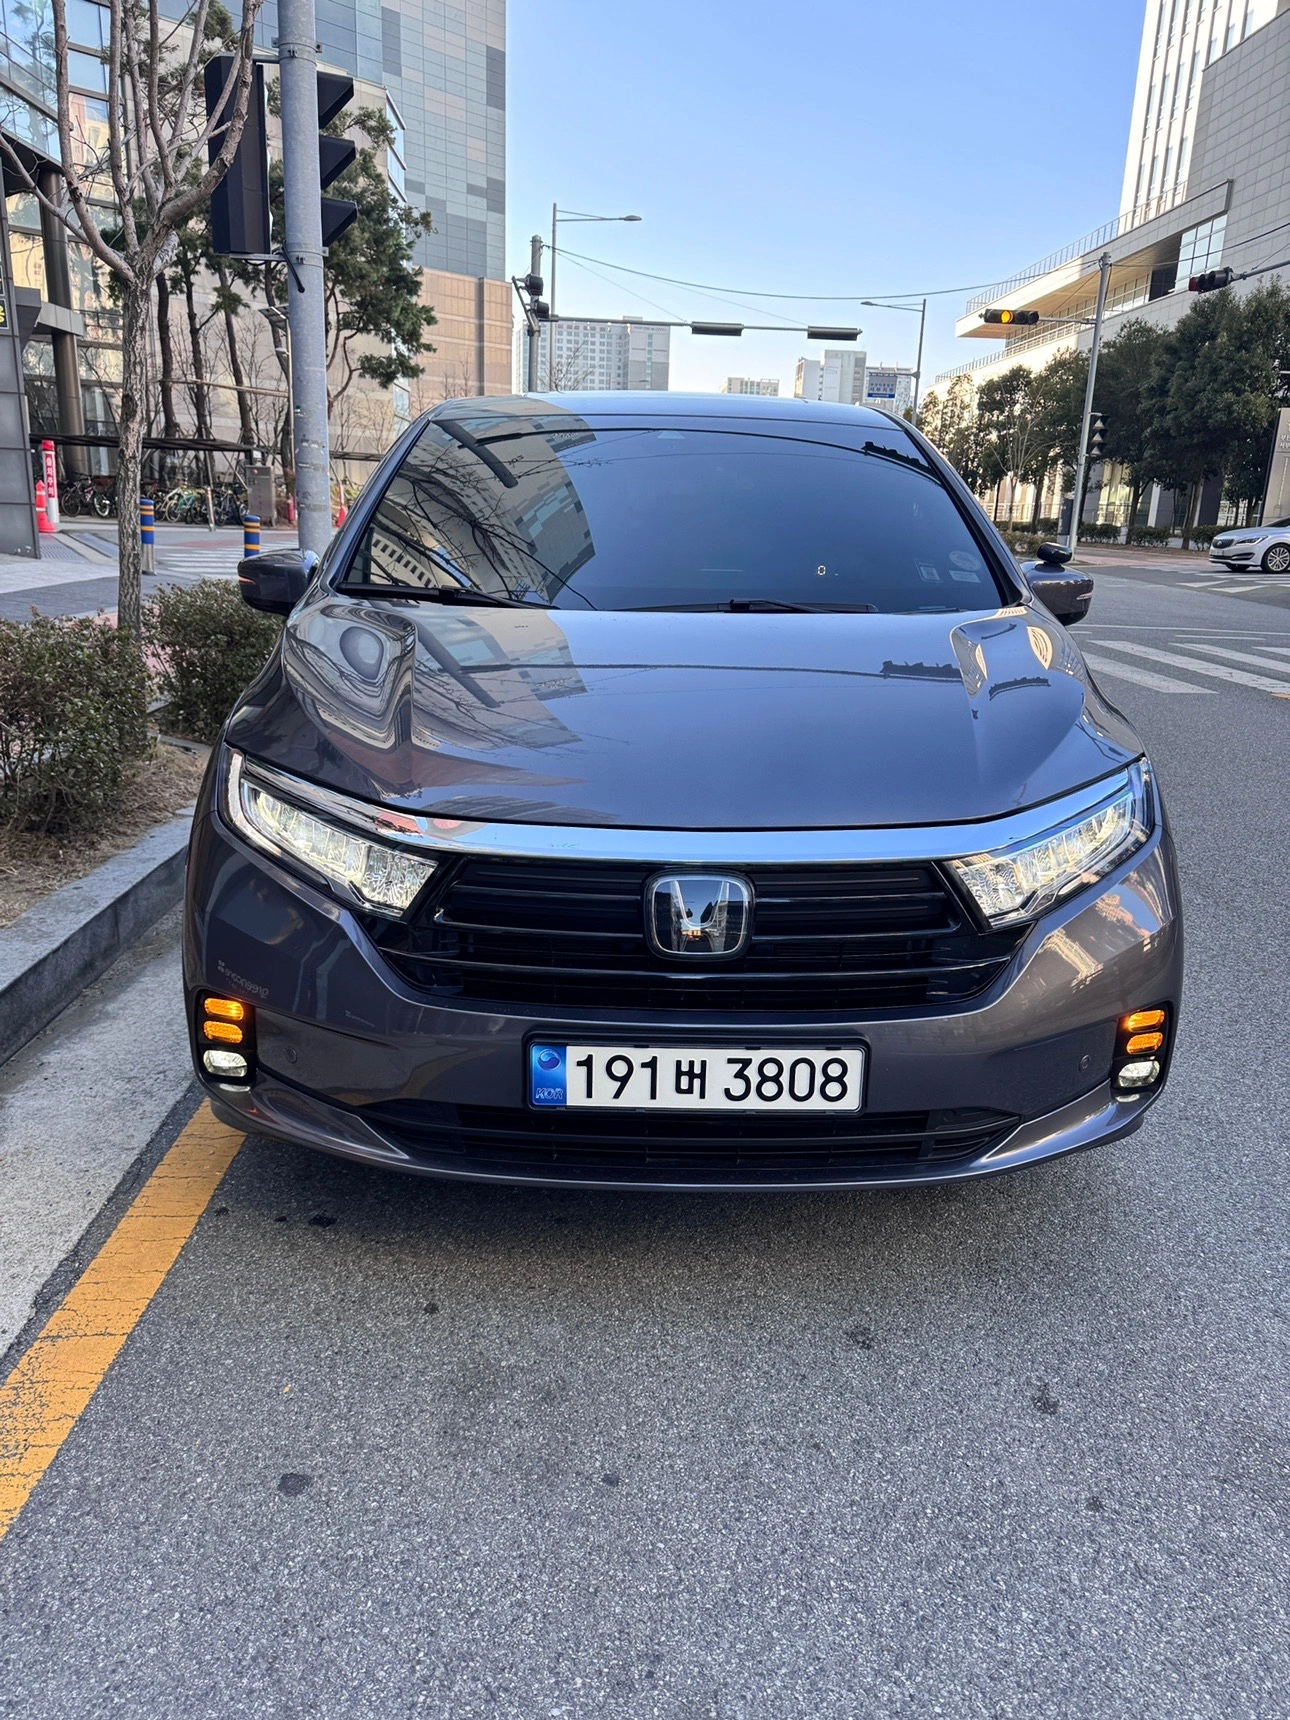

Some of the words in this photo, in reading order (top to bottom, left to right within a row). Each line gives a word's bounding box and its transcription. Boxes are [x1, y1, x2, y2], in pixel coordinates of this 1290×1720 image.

[535, 1087, 564, 1100] KOR
[576, 1053, 707, 1101] 191버
[724, 1057, 849, 1103] 3808
